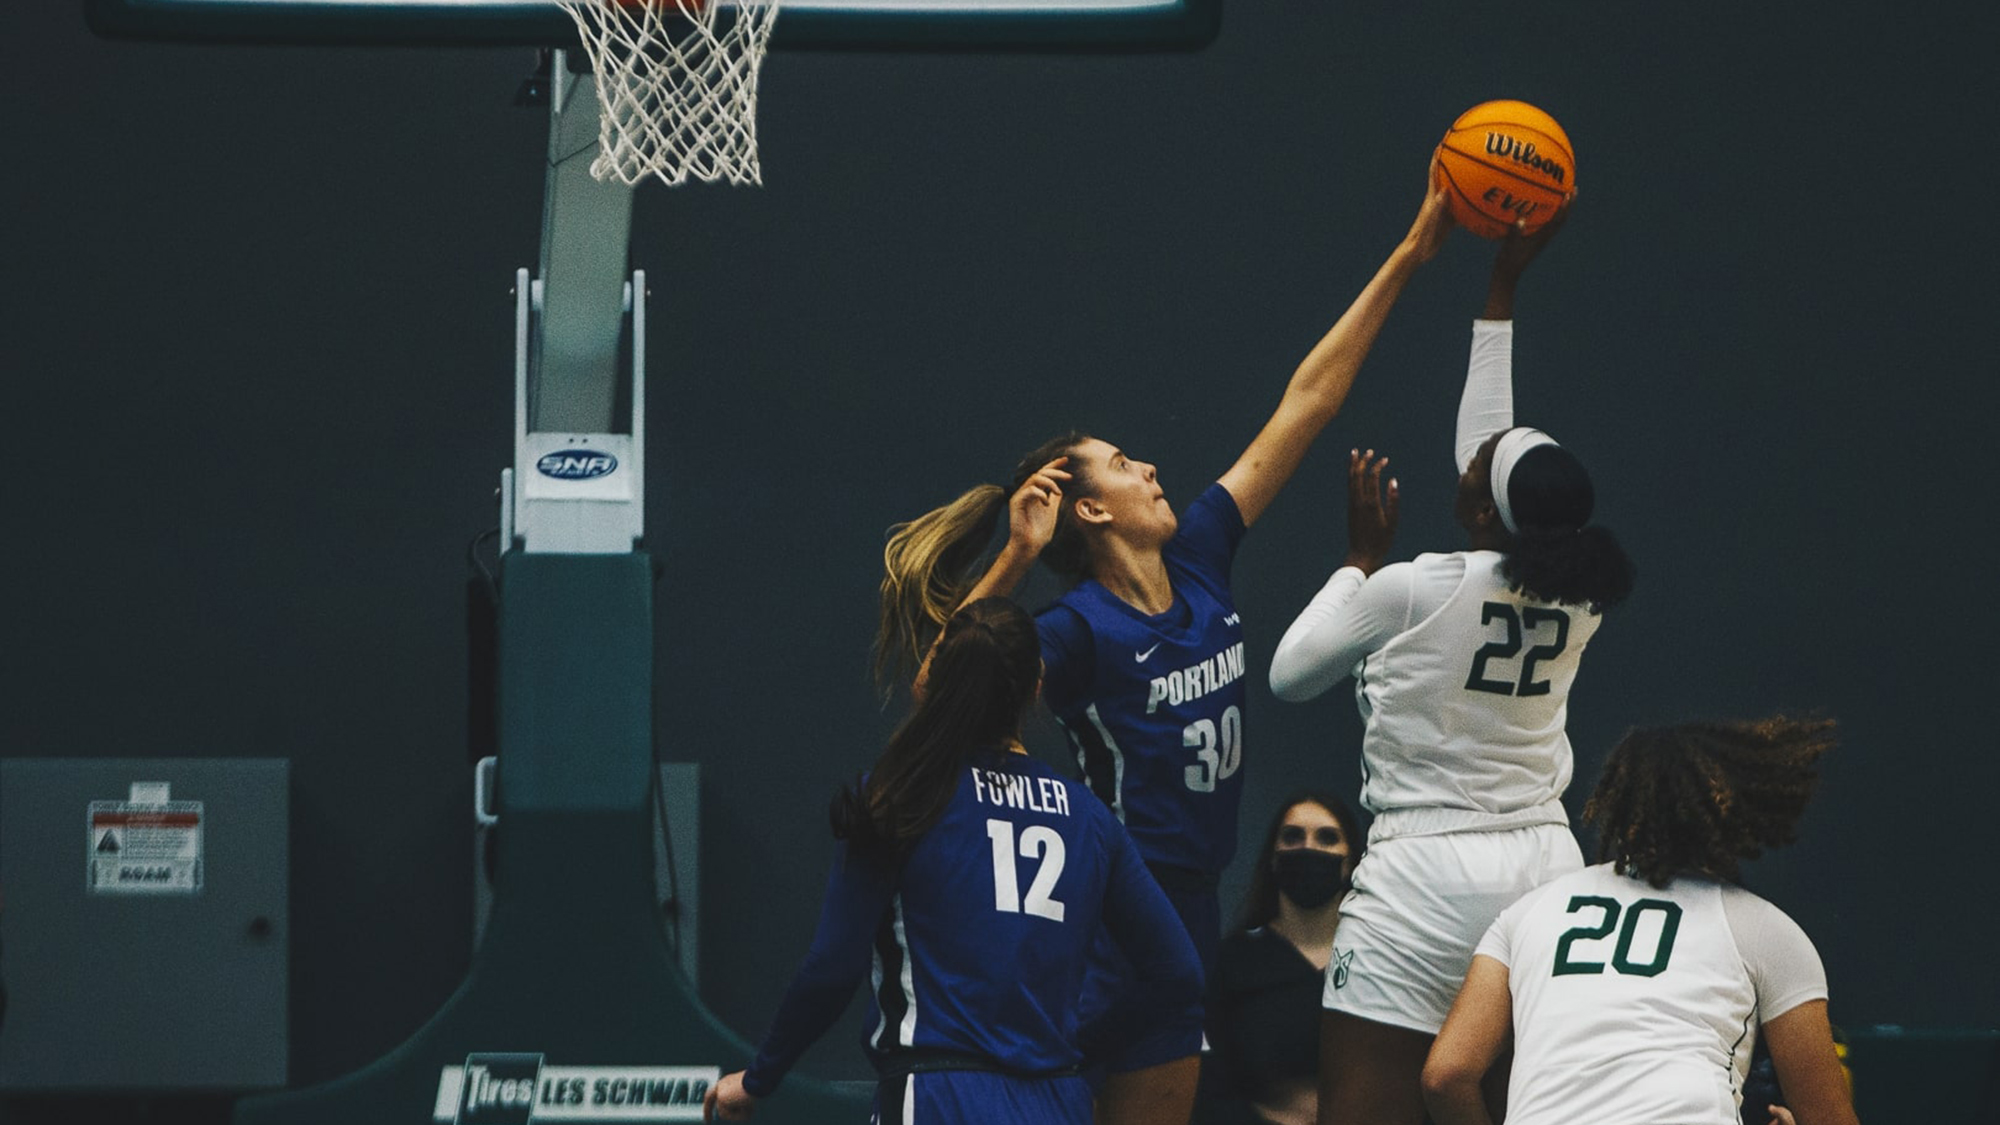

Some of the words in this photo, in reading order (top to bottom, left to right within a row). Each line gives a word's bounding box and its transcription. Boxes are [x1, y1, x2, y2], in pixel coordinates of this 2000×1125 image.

[1486, 132, 1565, 184] Wilson
[1146, 641, 1245, 714] PORTLAND
[1464, 601, 1570, 697] 22
[1183, 705, 1242, 792] 30
[971, 766, 1070, 816] FOWLER
[986, 818, 1066, 923] 12
[1552, 895, 1683, 977] 20
[465, 1065, 534, 1112] Tires
[540, 1076, 586, 1105] LES
